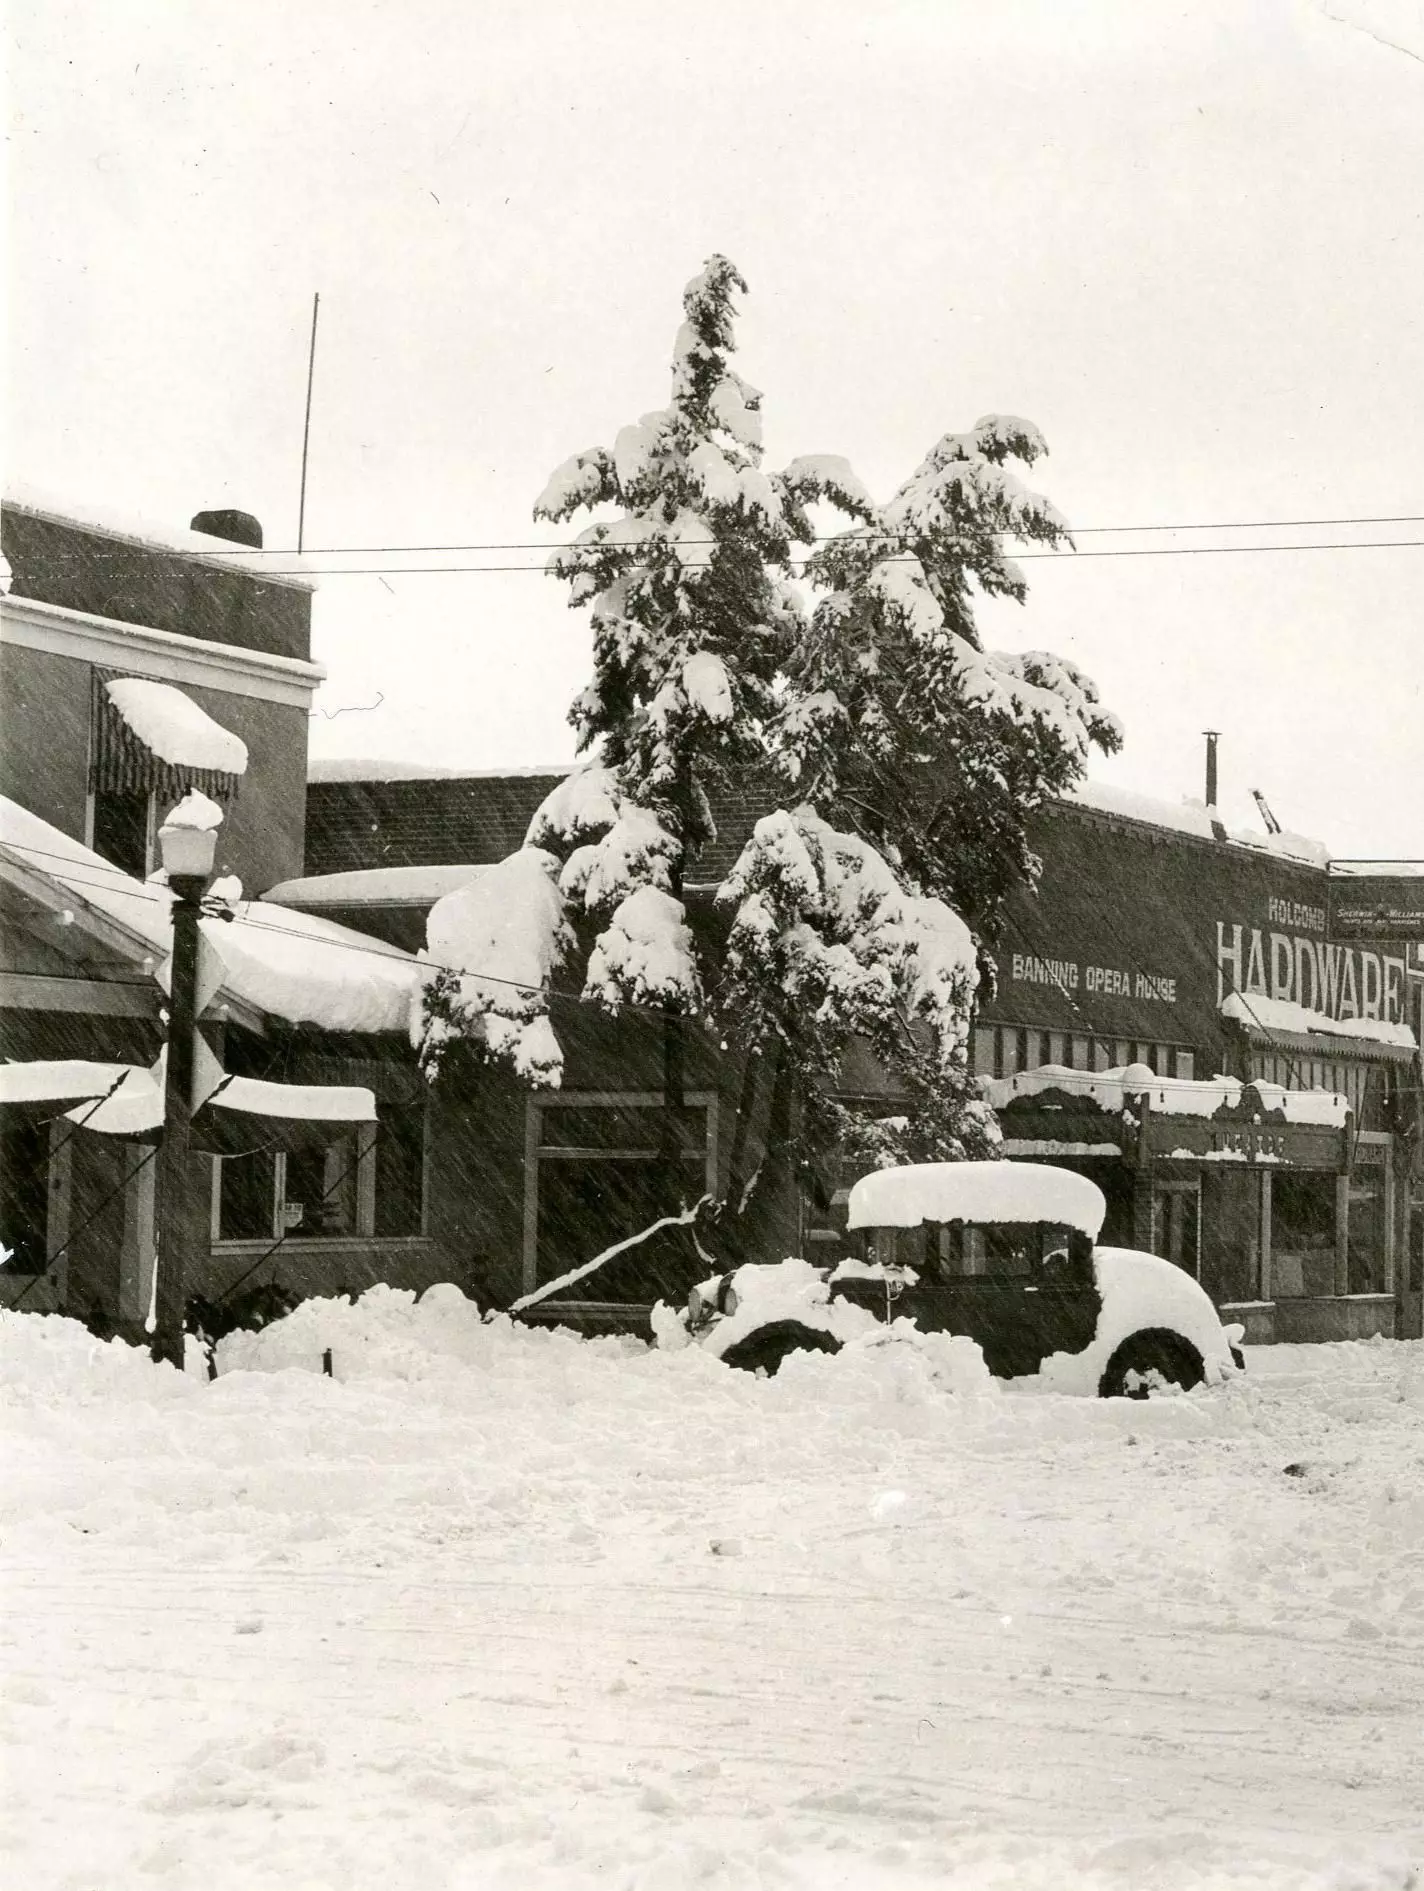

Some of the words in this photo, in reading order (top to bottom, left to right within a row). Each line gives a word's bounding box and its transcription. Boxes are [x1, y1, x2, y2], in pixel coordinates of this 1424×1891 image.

[1269, 897, 1325, 931] HOLCOMB
[1012, 953, 1080, 989] BANNING
[1086, 966, 1132, 997] OPERA
[1135, 973, 1177, 1003] HOUSE
[1216, 920, 1406, 1025] HARDWARE
